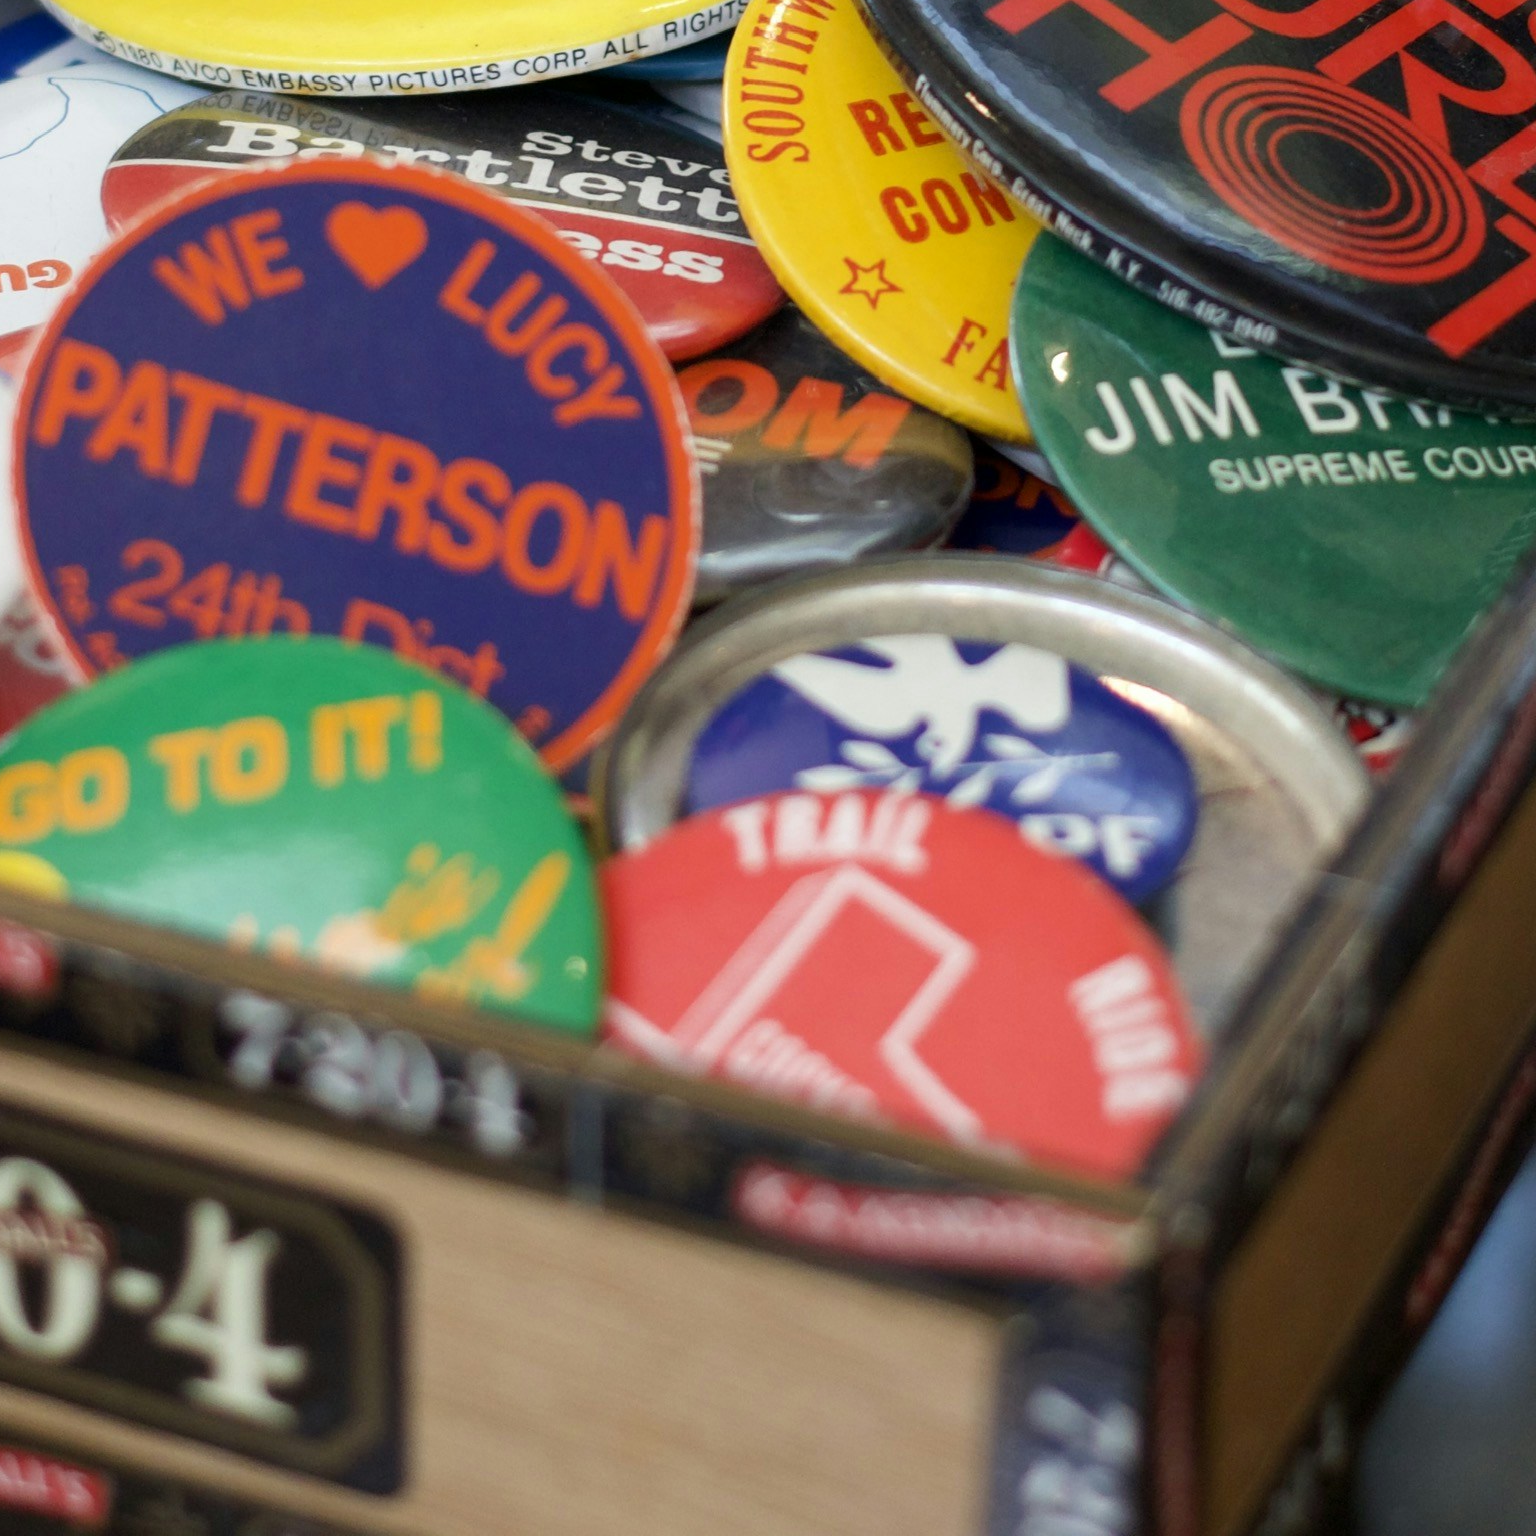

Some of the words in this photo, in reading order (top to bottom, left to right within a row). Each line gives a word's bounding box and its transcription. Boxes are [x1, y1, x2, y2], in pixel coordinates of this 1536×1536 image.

[173, 57, 233, 84] AVCO
[242, 69, 358, 93] EMBASSY
[369, 63, 502, 92] PICTURES
[512, 49, 589, 77] CORP.
[603, 32, 650, 61] ALL
[153, 209, 305, 327] WE
[436, 238, 644, 428] LUCY
[1084, 370, 1262, 456] JIM
[32, 339, 668, 624] PATTERSON
[1208, 447, 1416, 495] SUPREME
[147, 714, 290, 816] TO
[307, 689, 444, 792] IT!
